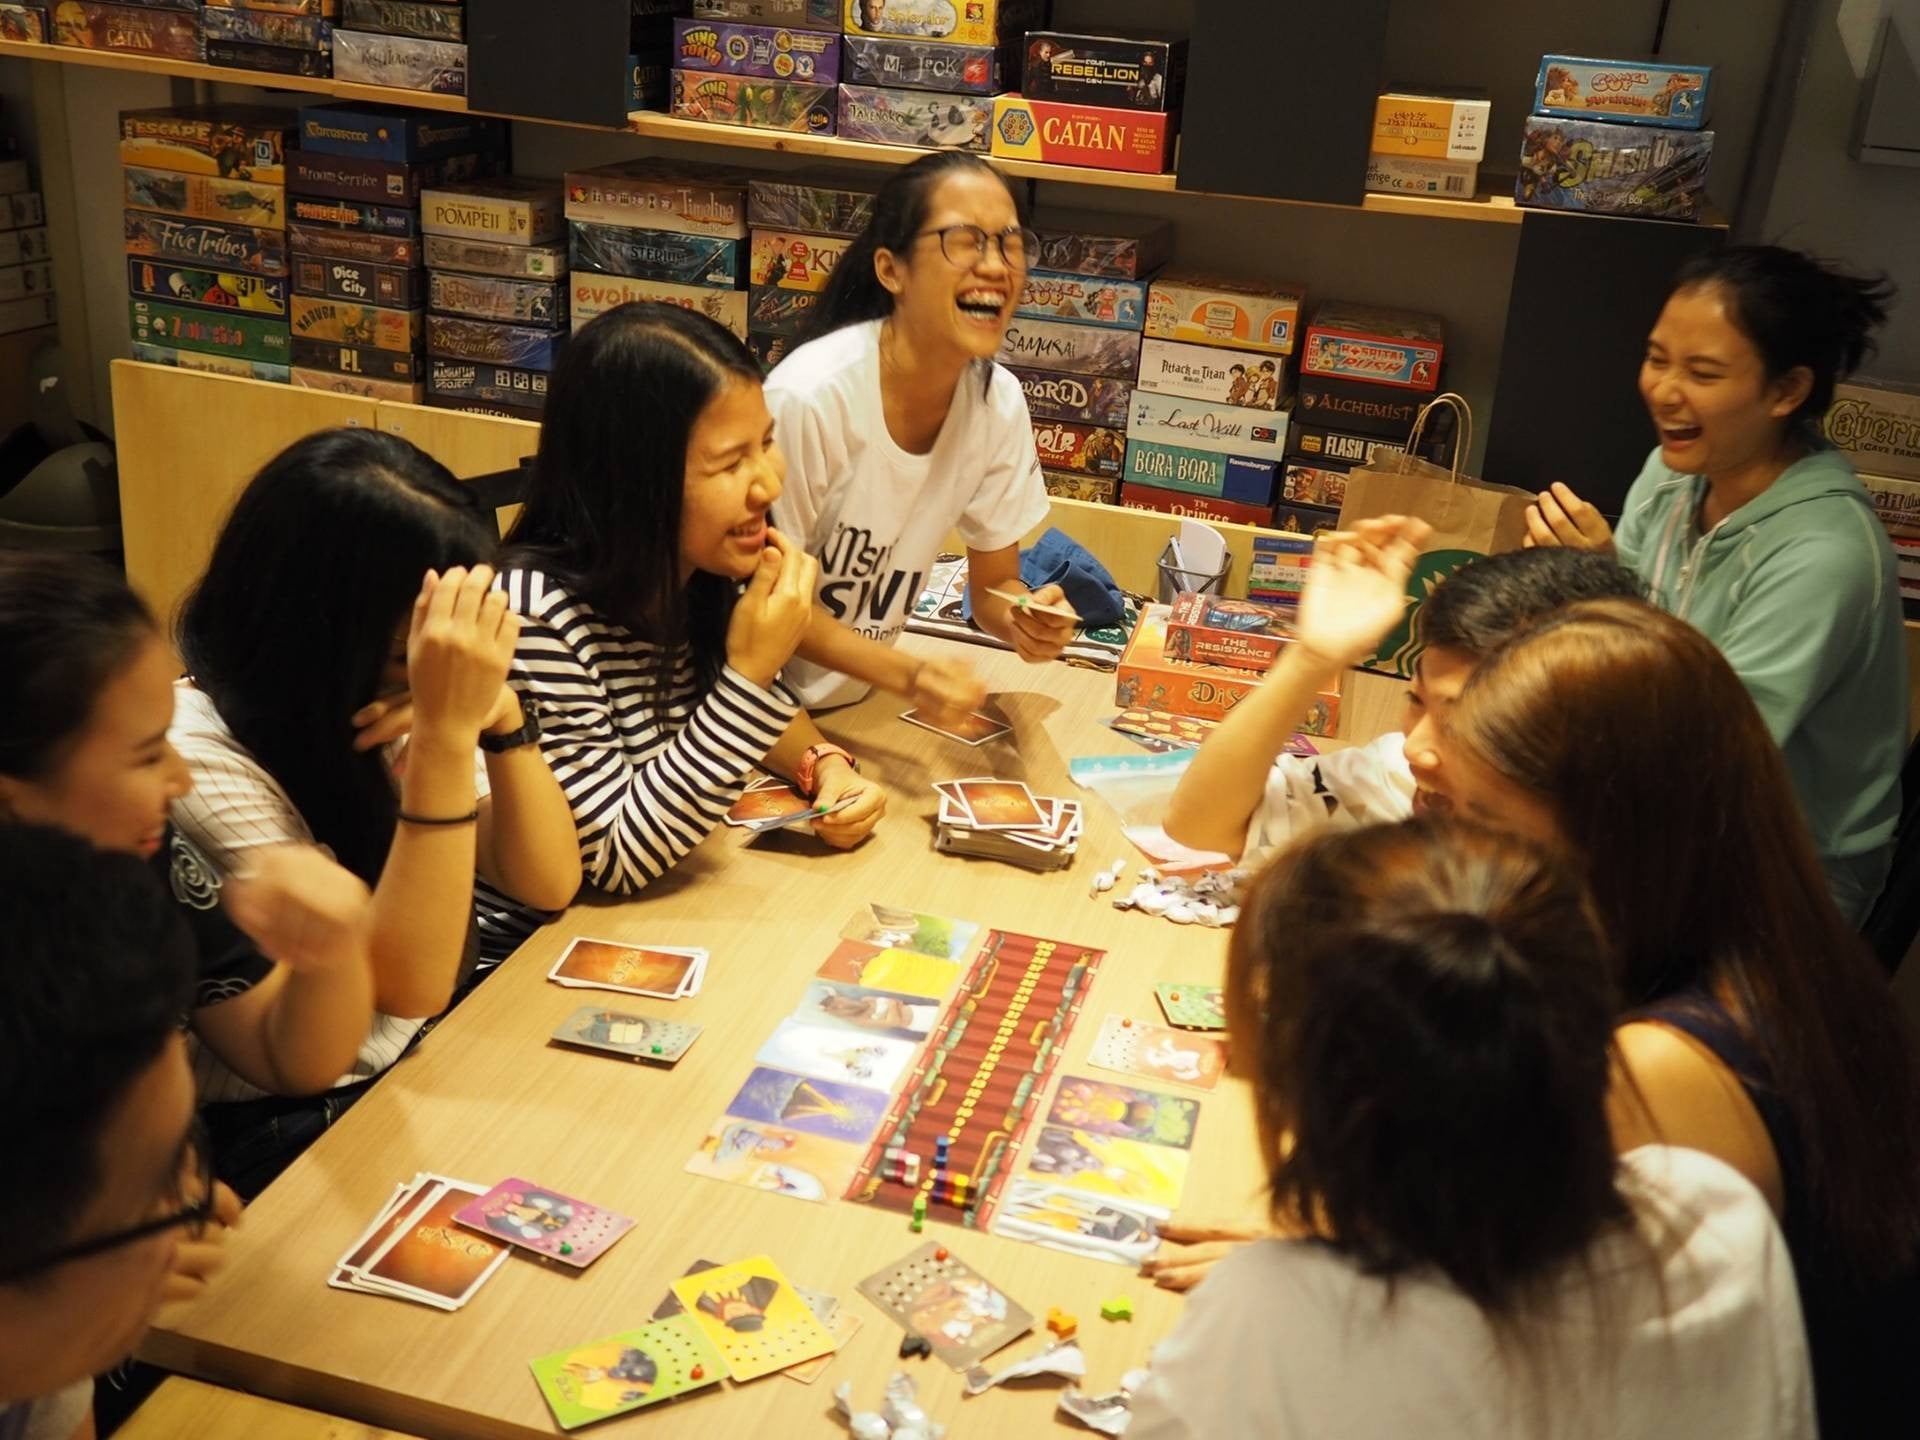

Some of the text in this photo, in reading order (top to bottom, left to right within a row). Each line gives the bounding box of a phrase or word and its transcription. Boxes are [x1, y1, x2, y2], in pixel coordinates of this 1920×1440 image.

[107, 28, 153, 49] CATAN
[685, 30, 719, 49] KING
[680, 44, 722, 67] TOKYO
[1050, 63, 1140, 81] REBELLION
[695, 79, 729, 98] KING
[134, 121, 212, 141] ESCAPE
[1042, 117, 1127, 152] CATAN
[336, 172, 378, 187] Service
[677, 188, 734, 219] Timeline
[436, 206, 499, 229] POMPEII
[151, 218, 248, 257] Five Tribes
[332, 265, 360, 280] Dice
[341, 280, 367, 297] City
[1162, 359, 1191, 376] Attack
[1202, 366, 1225, 380] Titan
[434, 379, 473, 390] PROJECT
[1020, 379, 1088, 408] WORLD
[1158, 408, 1200, 430] Last
[1203, 413, 1243, 437] Will
[1324, 435, 1365, 460] FLASH
[1135, 449, 1217, 485] BORA BORA
[1228, 457, 1272, 471] Ravensburger
[1195, 642, 1272, 659] RESISTANCE
[1221, 637, 1248, 648] THE
